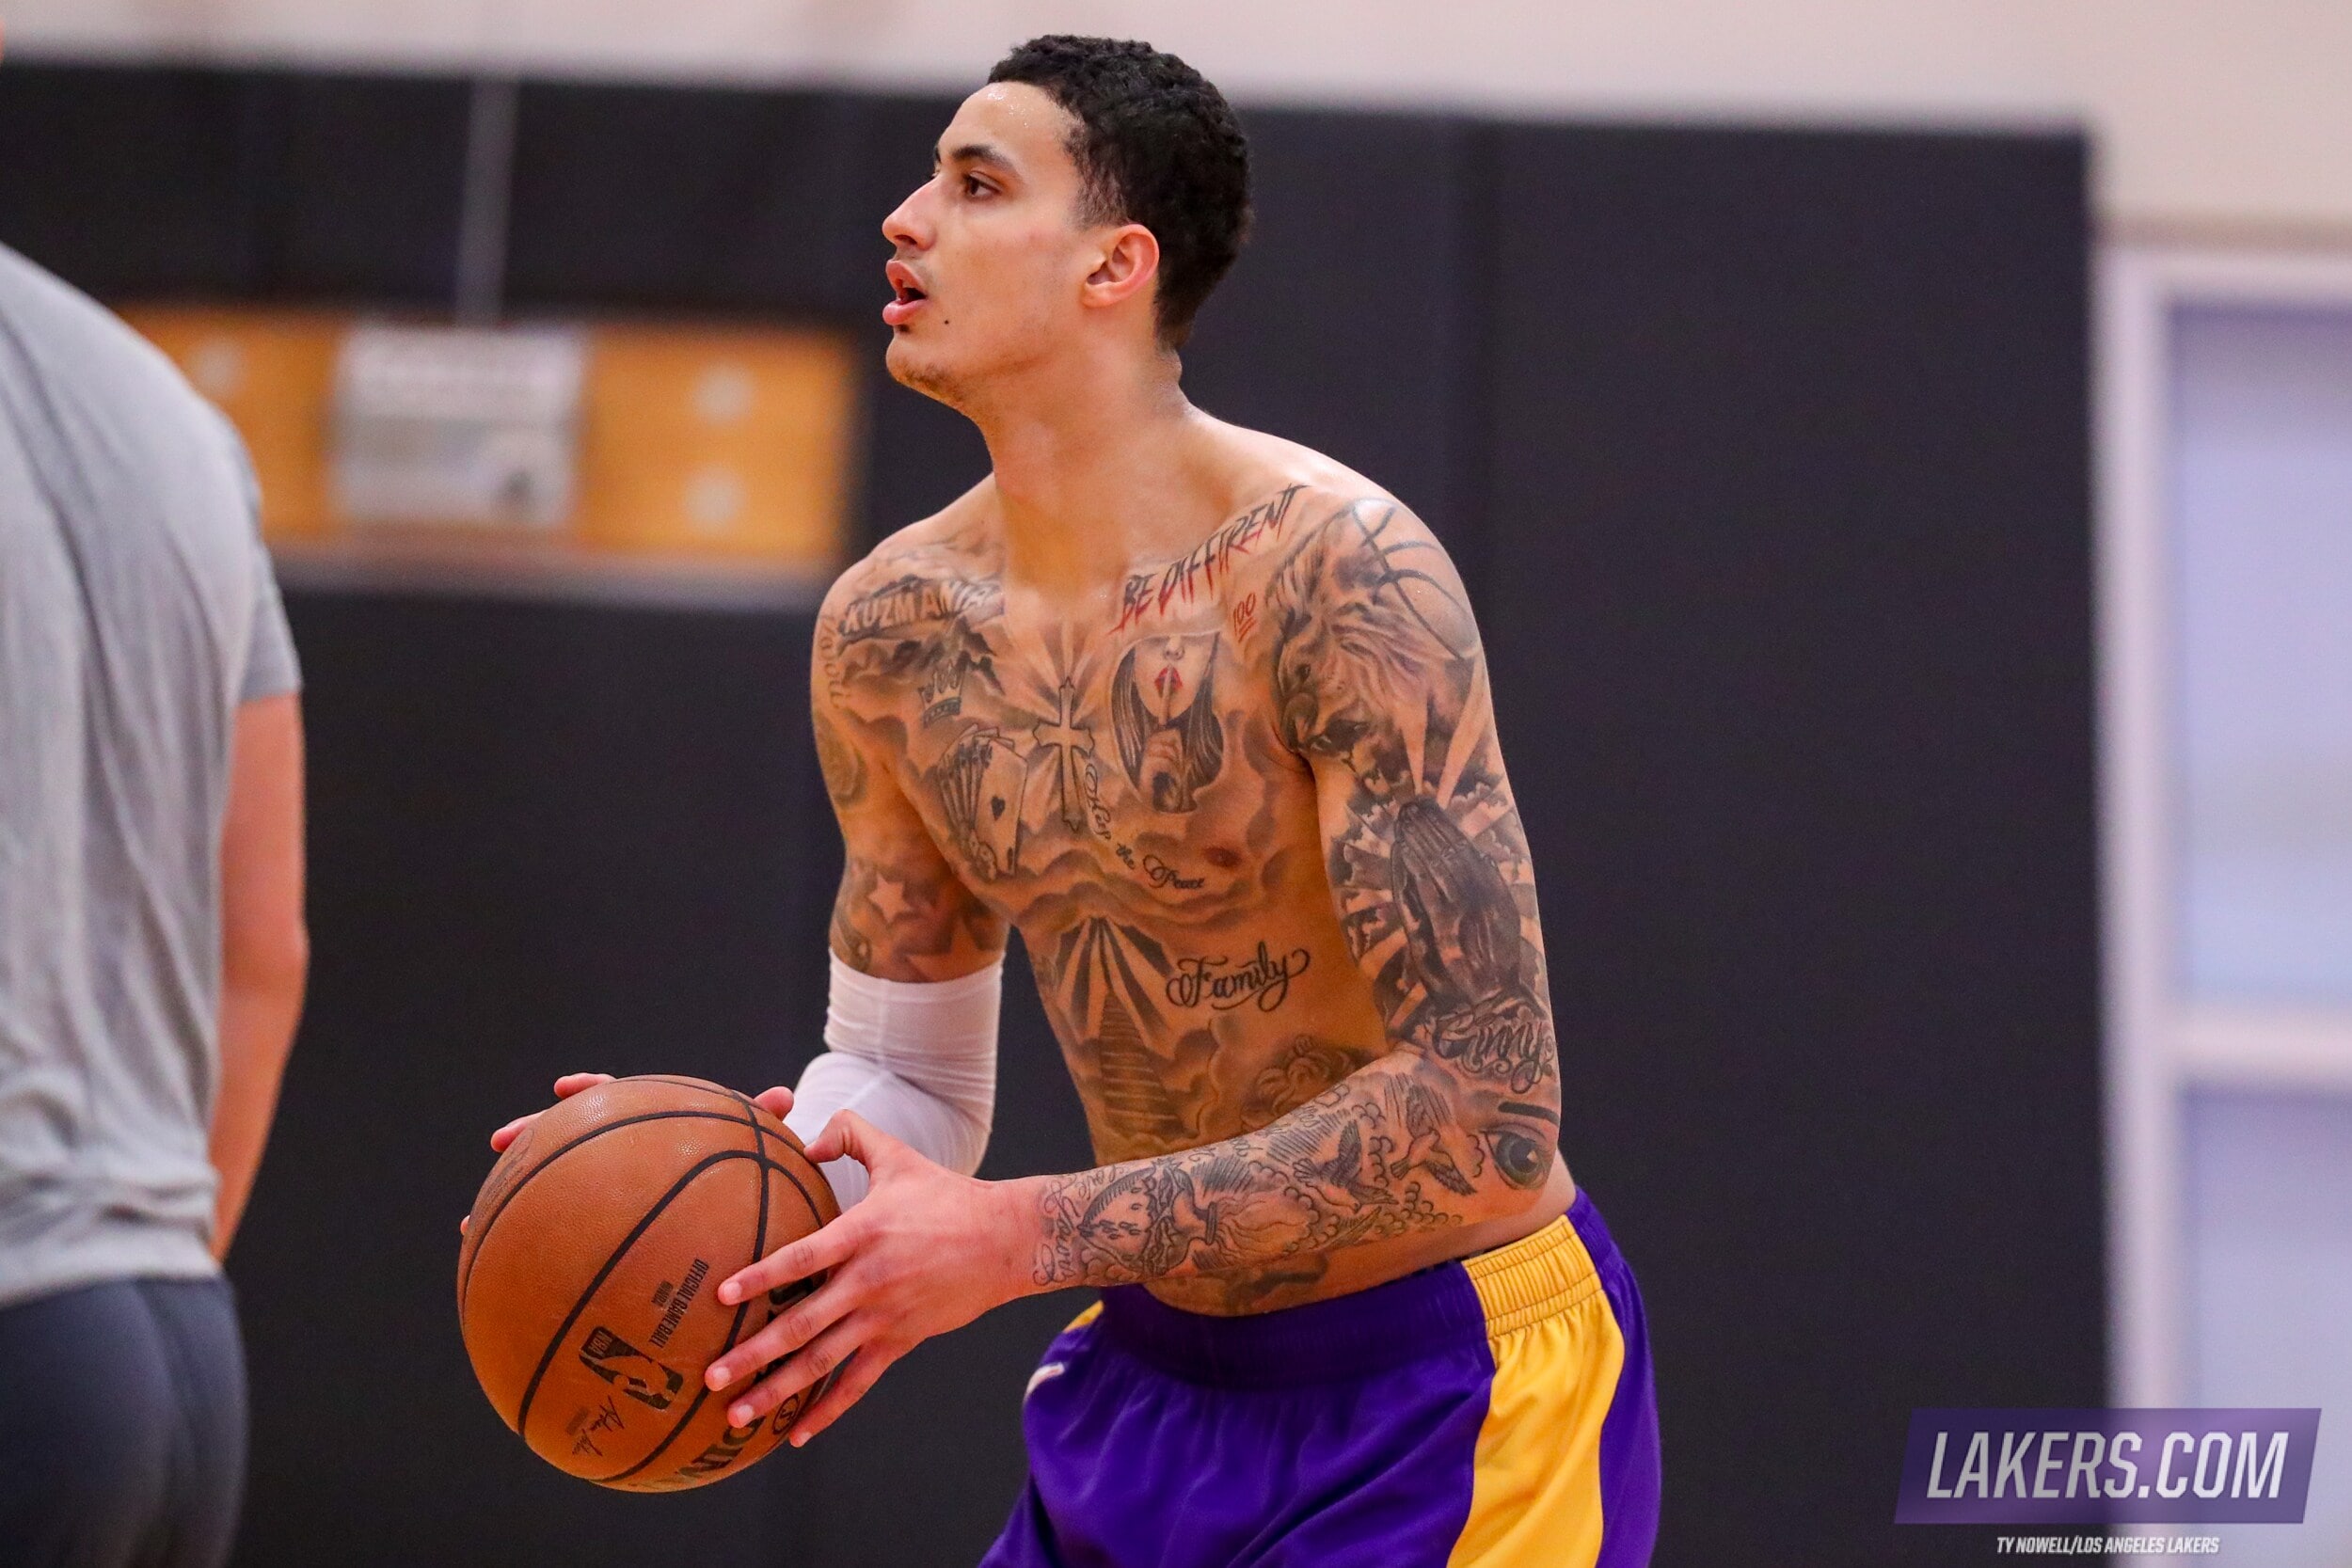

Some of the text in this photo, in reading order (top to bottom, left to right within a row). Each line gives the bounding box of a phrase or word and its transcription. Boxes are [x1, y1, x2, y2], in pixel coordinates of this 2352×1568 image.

[1107, 573, 1158, 636] BE
[1116, 843, 1136, 870] the
[1166, 941, 1311, 1013] Family
[648, 1259, 709, 1349] OFFICIAL GAME BALL
[588, 1330, 612, 1356] NBA
